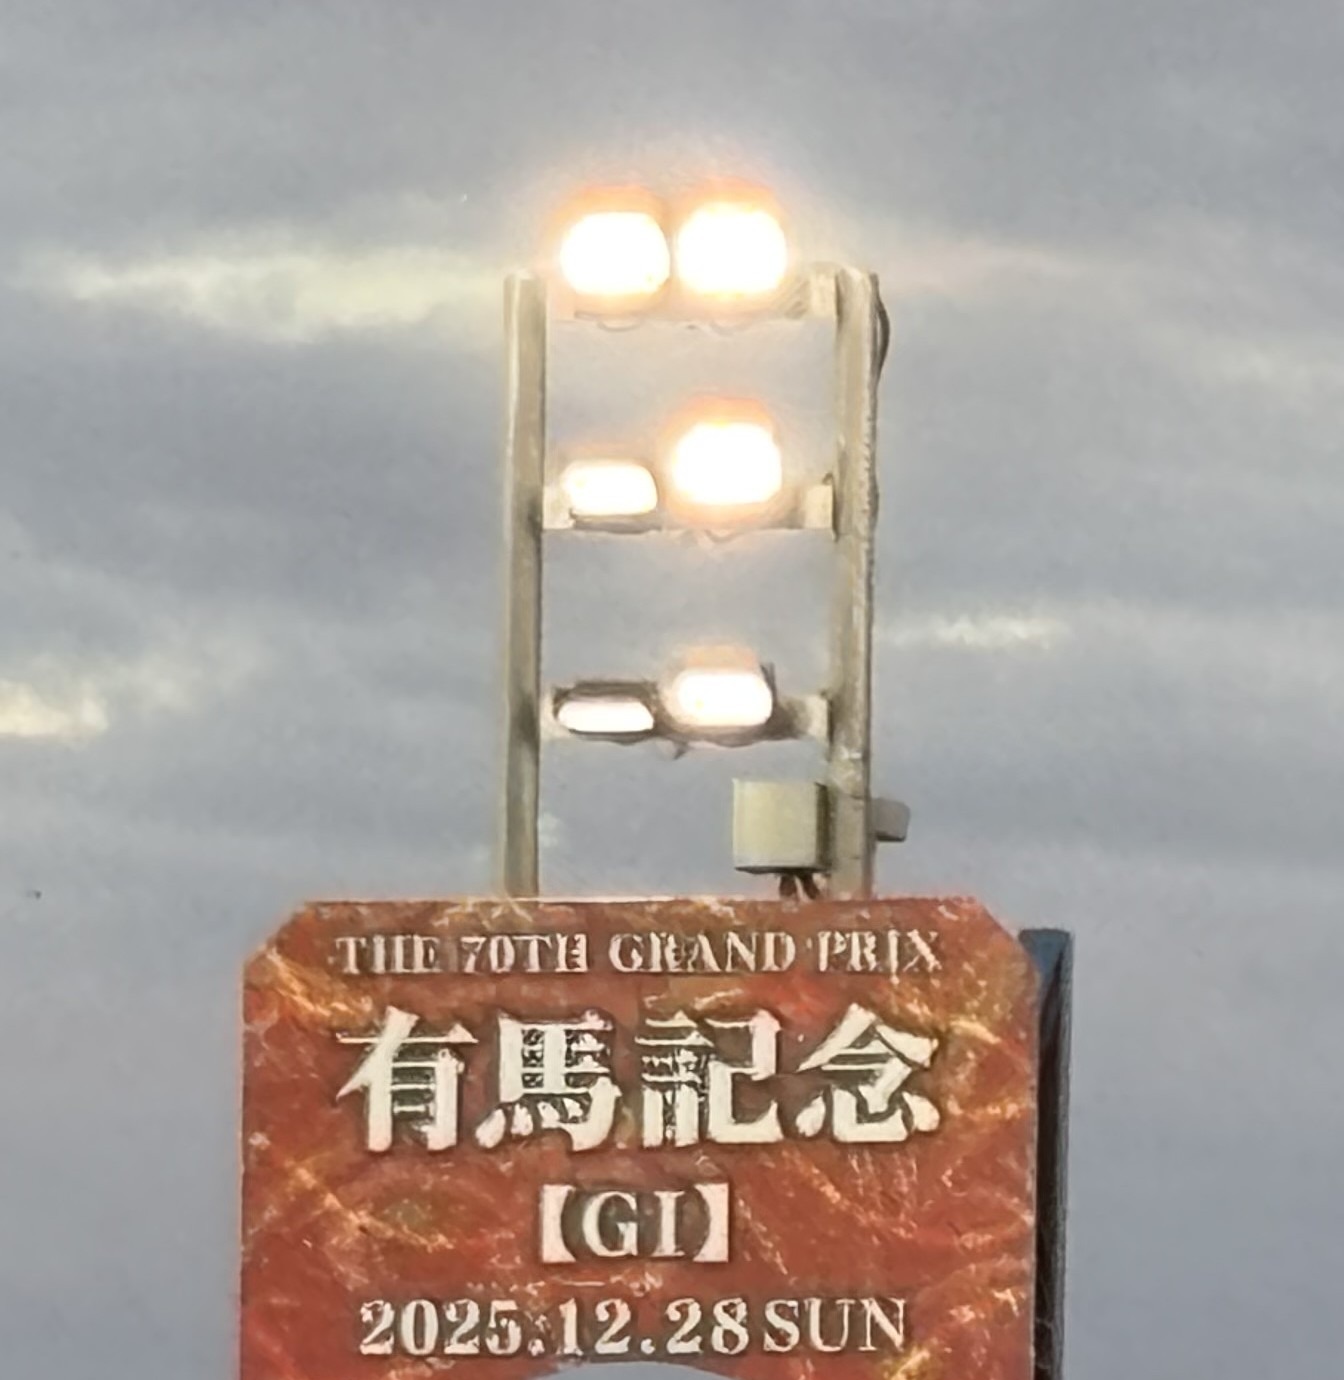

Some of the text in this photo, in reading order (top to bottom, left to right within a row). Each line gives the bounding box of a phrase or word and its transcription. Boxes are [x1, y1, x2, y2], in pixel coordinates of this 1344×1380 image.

[336, 930, 942, 975] THE 70TH GRAND PRIX
[336, 1003, 943, 1153] 有馬記念
